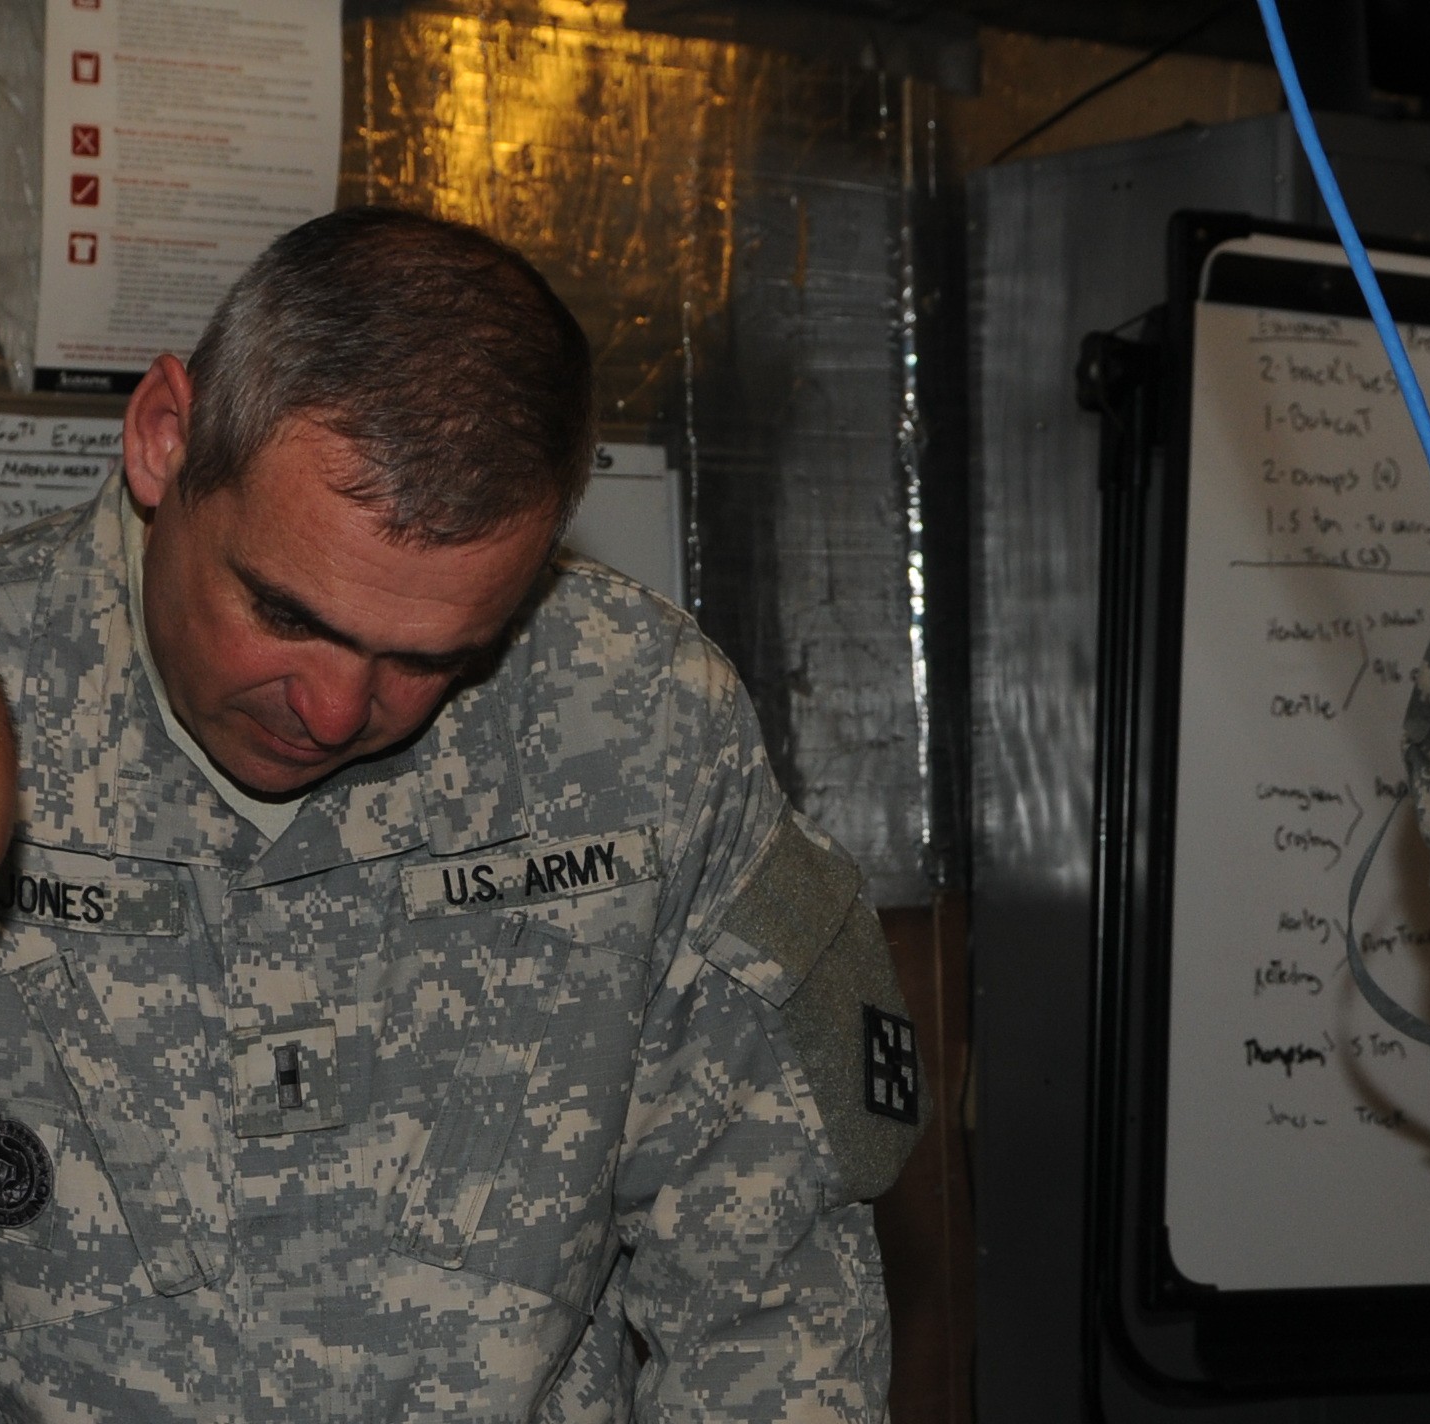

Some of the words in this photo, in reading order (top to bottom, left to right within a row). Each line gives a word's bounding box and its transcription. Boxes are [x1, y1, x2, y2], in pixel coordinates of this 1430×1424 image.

[0, 871, 104, 923] JONES
[444, 866, 503, 907] U.S.
[524, 841, 619, 898] ARMY
